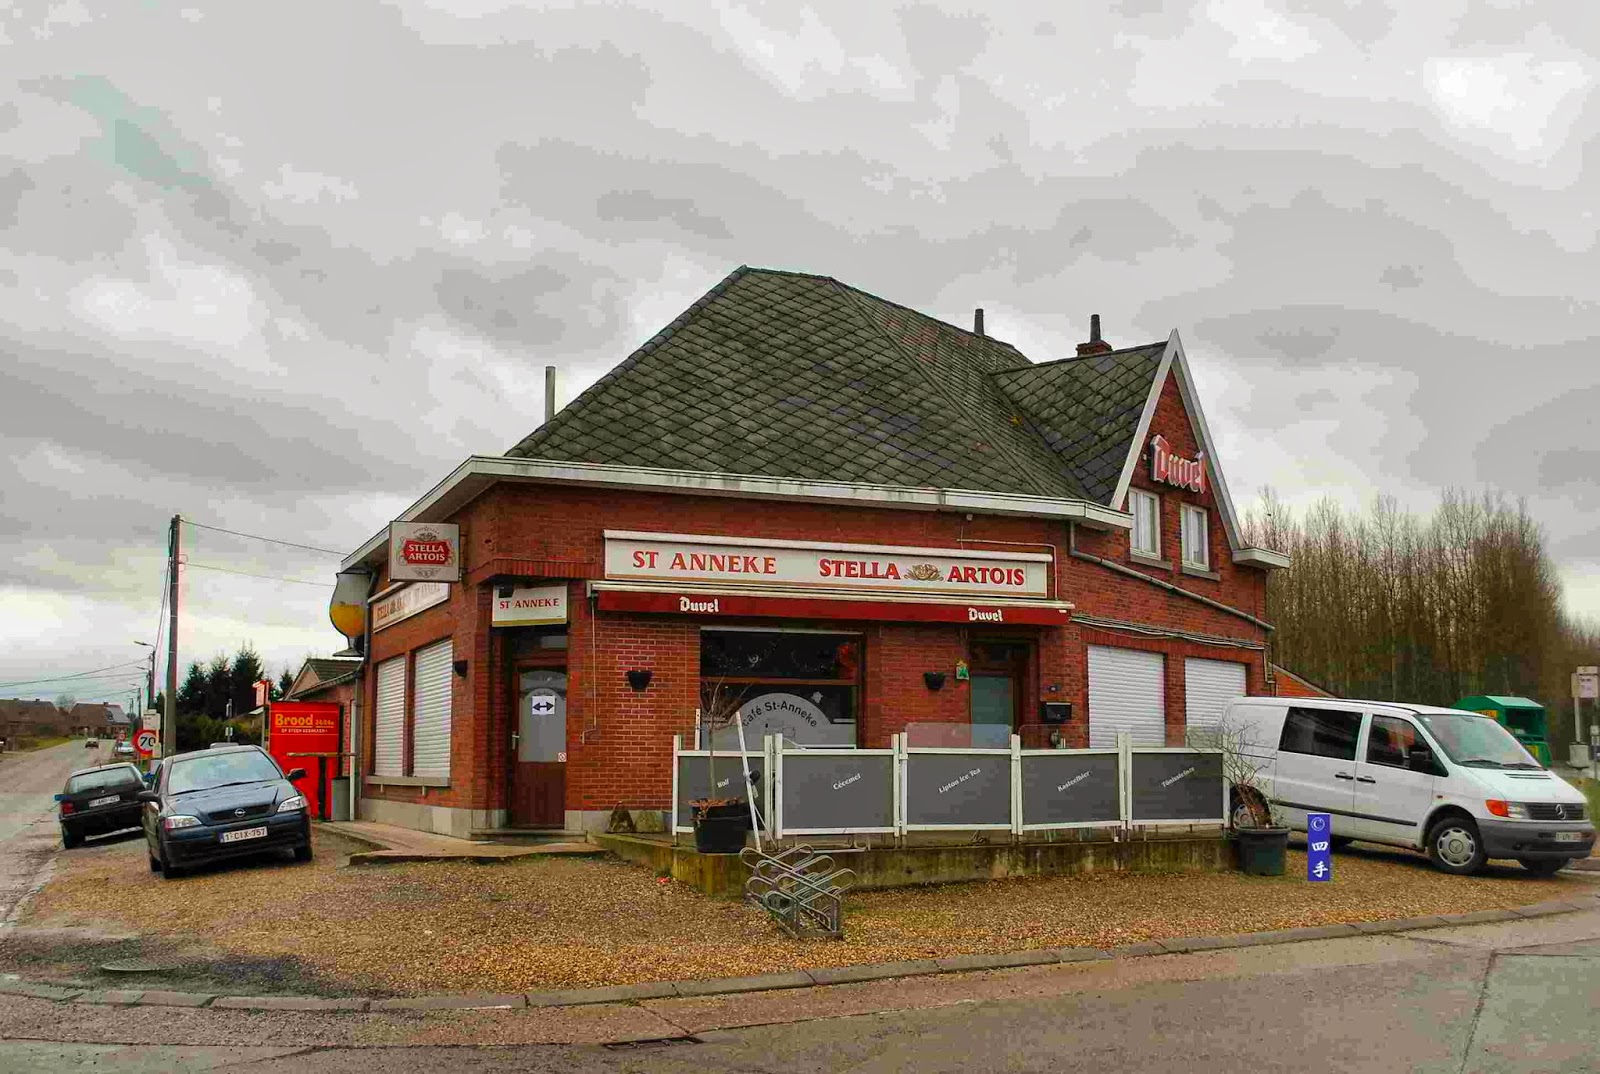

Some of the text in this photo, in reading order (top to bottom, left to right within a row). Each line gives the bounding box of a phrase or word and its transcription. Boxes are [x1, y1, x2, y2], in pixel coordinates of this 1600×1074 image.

[408, 544, 445, 552] STELLA
[408, 553, 446, 561] ARTOIS
[632, 551, 777, 575] ST ANNEKE
[819, 558, 1025, 586] STELLA ARTOIS
[499, 598, 559, 609] ST ANNEKE
[678, 596, 720, 613] Duvel
[968, 607, 1004, 622] Duvel
[274, 713, 314, 726] Brood
[764, 700, 818, 728] St-Anneke
[140, 736, 156, 747] 70
